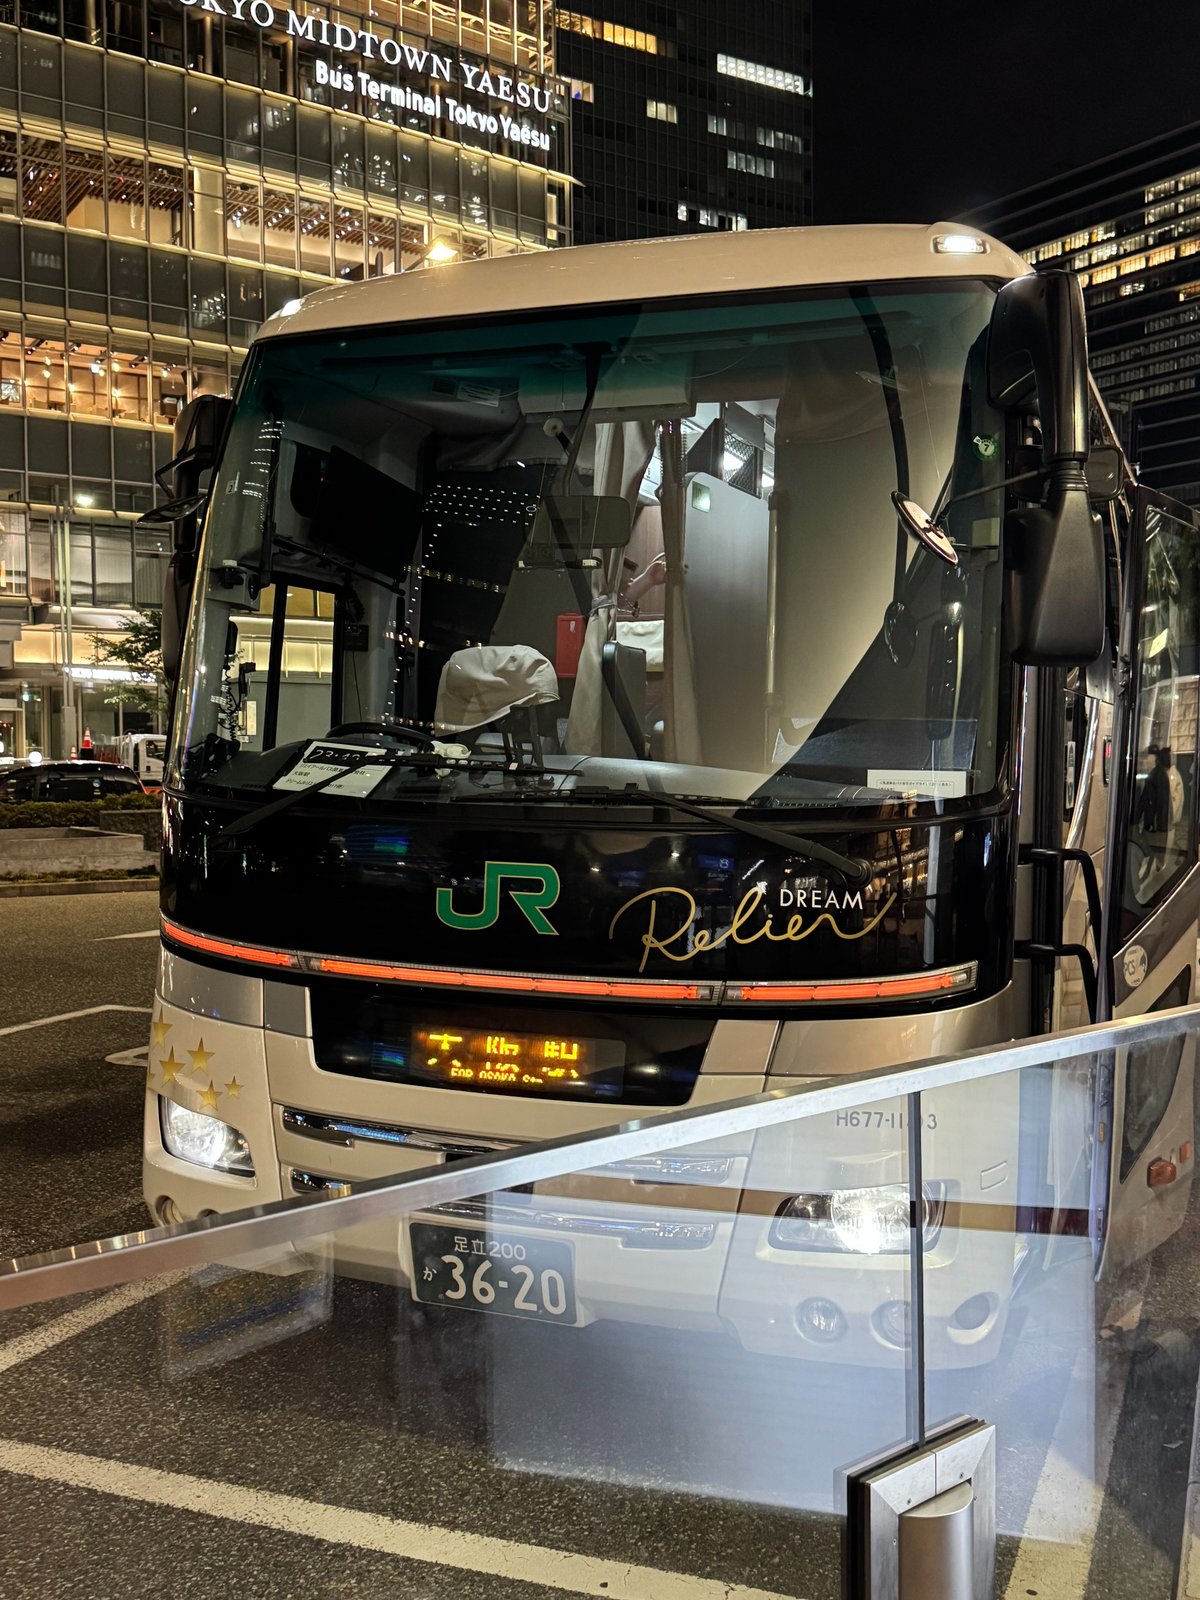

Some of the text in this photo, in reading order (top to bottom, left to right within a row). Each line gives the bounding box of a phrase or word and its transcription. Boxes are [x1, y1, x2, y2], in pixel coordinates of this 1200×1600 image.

[180, 0, 552, 113] KYO MIDTOWN YAESU
[315, 59, 551, 151] Bus Terminal Tokyo Yaesu
[436, 860, 560, 935] JR
[780, 888, 863, 910] DREAM
[609, 886, 897, 973] Relier
[836, 1110, 938, 1130] H677-113
[423, 1266, 438, 1282] か
[453, 1235, 527, 1261] 足立200
[440, 1254, 567, 1315] 36-20
